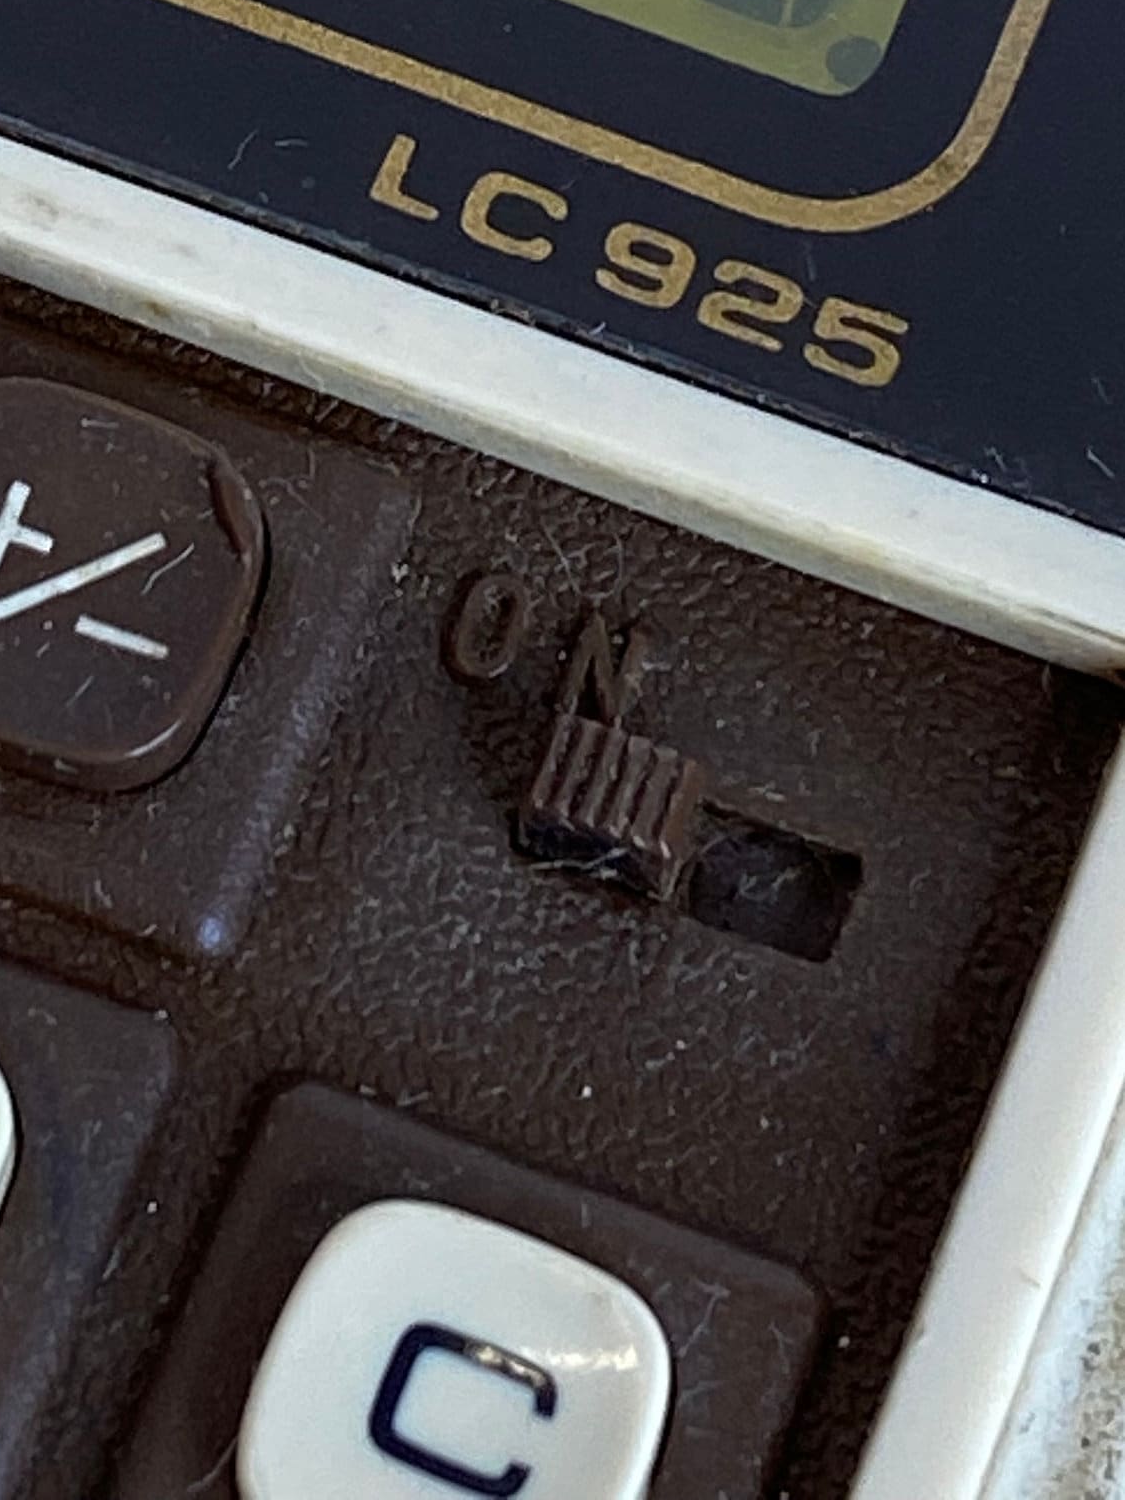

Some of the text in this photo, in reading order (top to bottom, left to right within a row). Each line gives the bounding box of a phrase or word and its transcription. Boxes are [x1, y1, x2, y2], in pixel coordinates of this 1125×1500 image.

[369, 134, 910, 387] LC 925
[442, 570, 653, 725] ON
[367, 1321, 558, 1498] C
